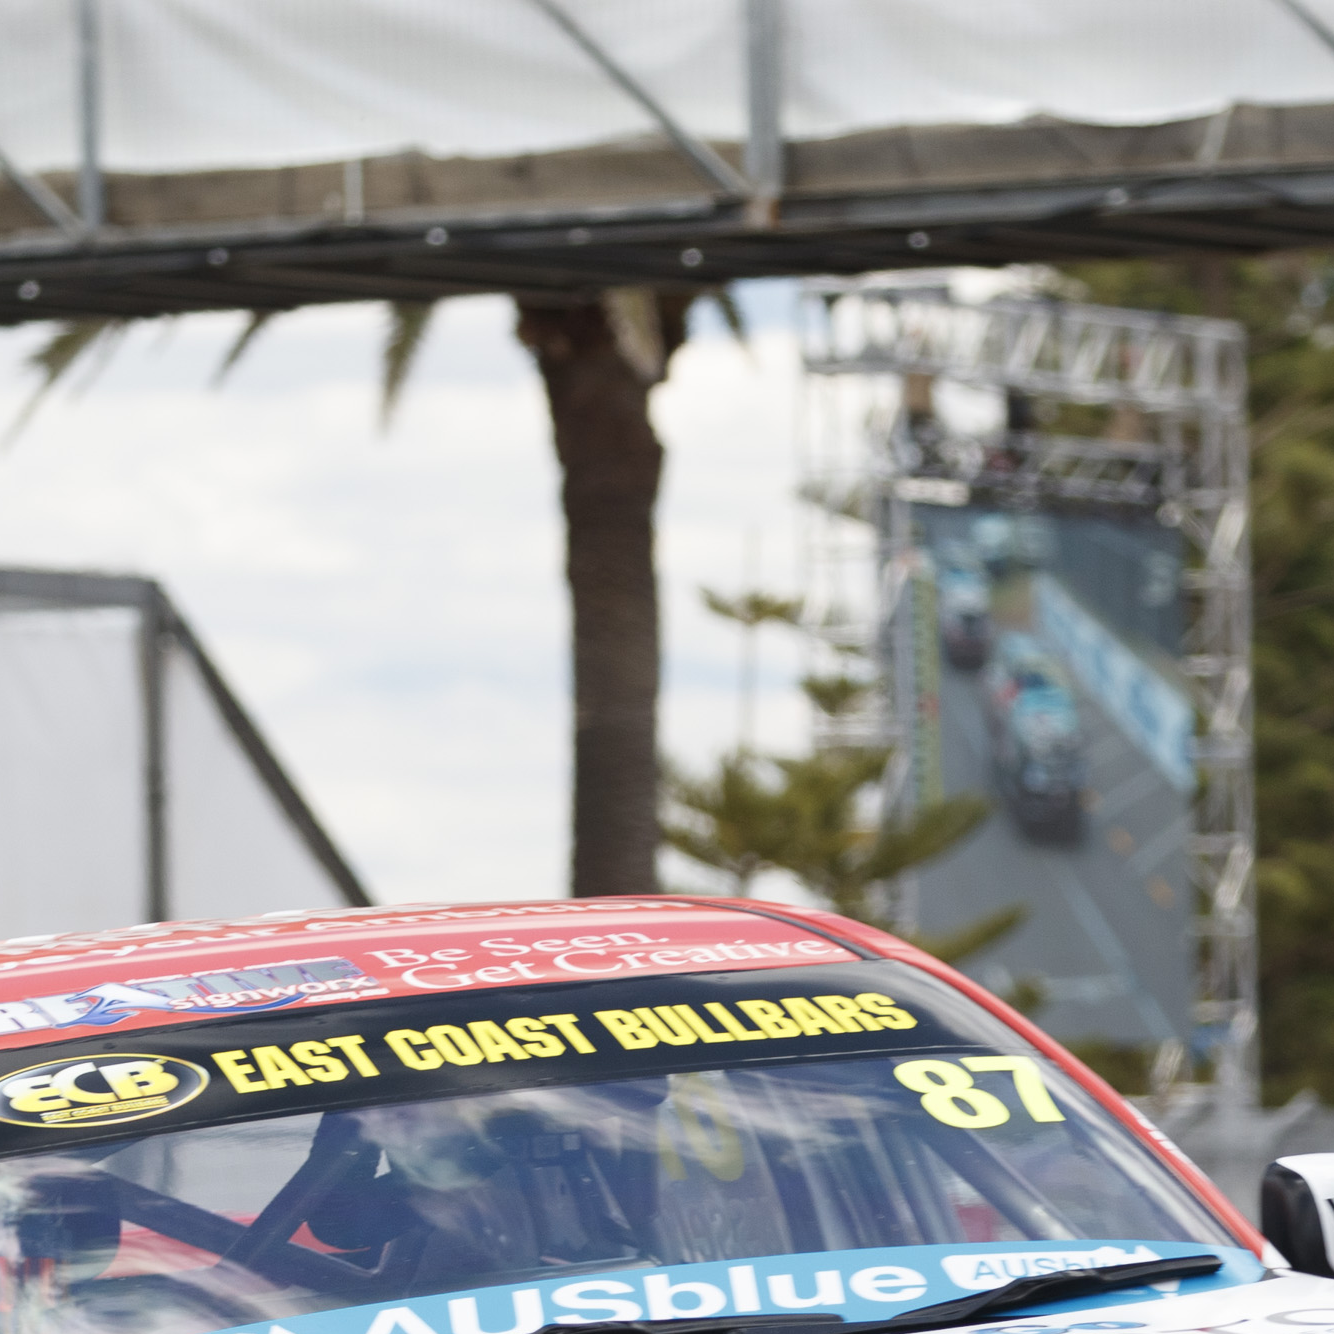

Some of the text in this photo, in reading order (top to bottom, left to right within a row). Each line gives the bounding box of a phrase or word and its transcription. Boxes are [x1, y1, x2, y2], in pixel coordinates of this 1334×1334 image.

[89, 926, 285, 957] your
[304, 901, 695, 931] Ambition
[364, 930, 670, 969] Be Seen.
[401, 938, 845, 990] Get Creative.
[167, 974, 370, 1011] signworx
[210, 991, 919, 1094] EAST COAST BULLBARS
[2, 1061, 180, 1113] ECB
[893, 1056, 1066, 1129] 87
